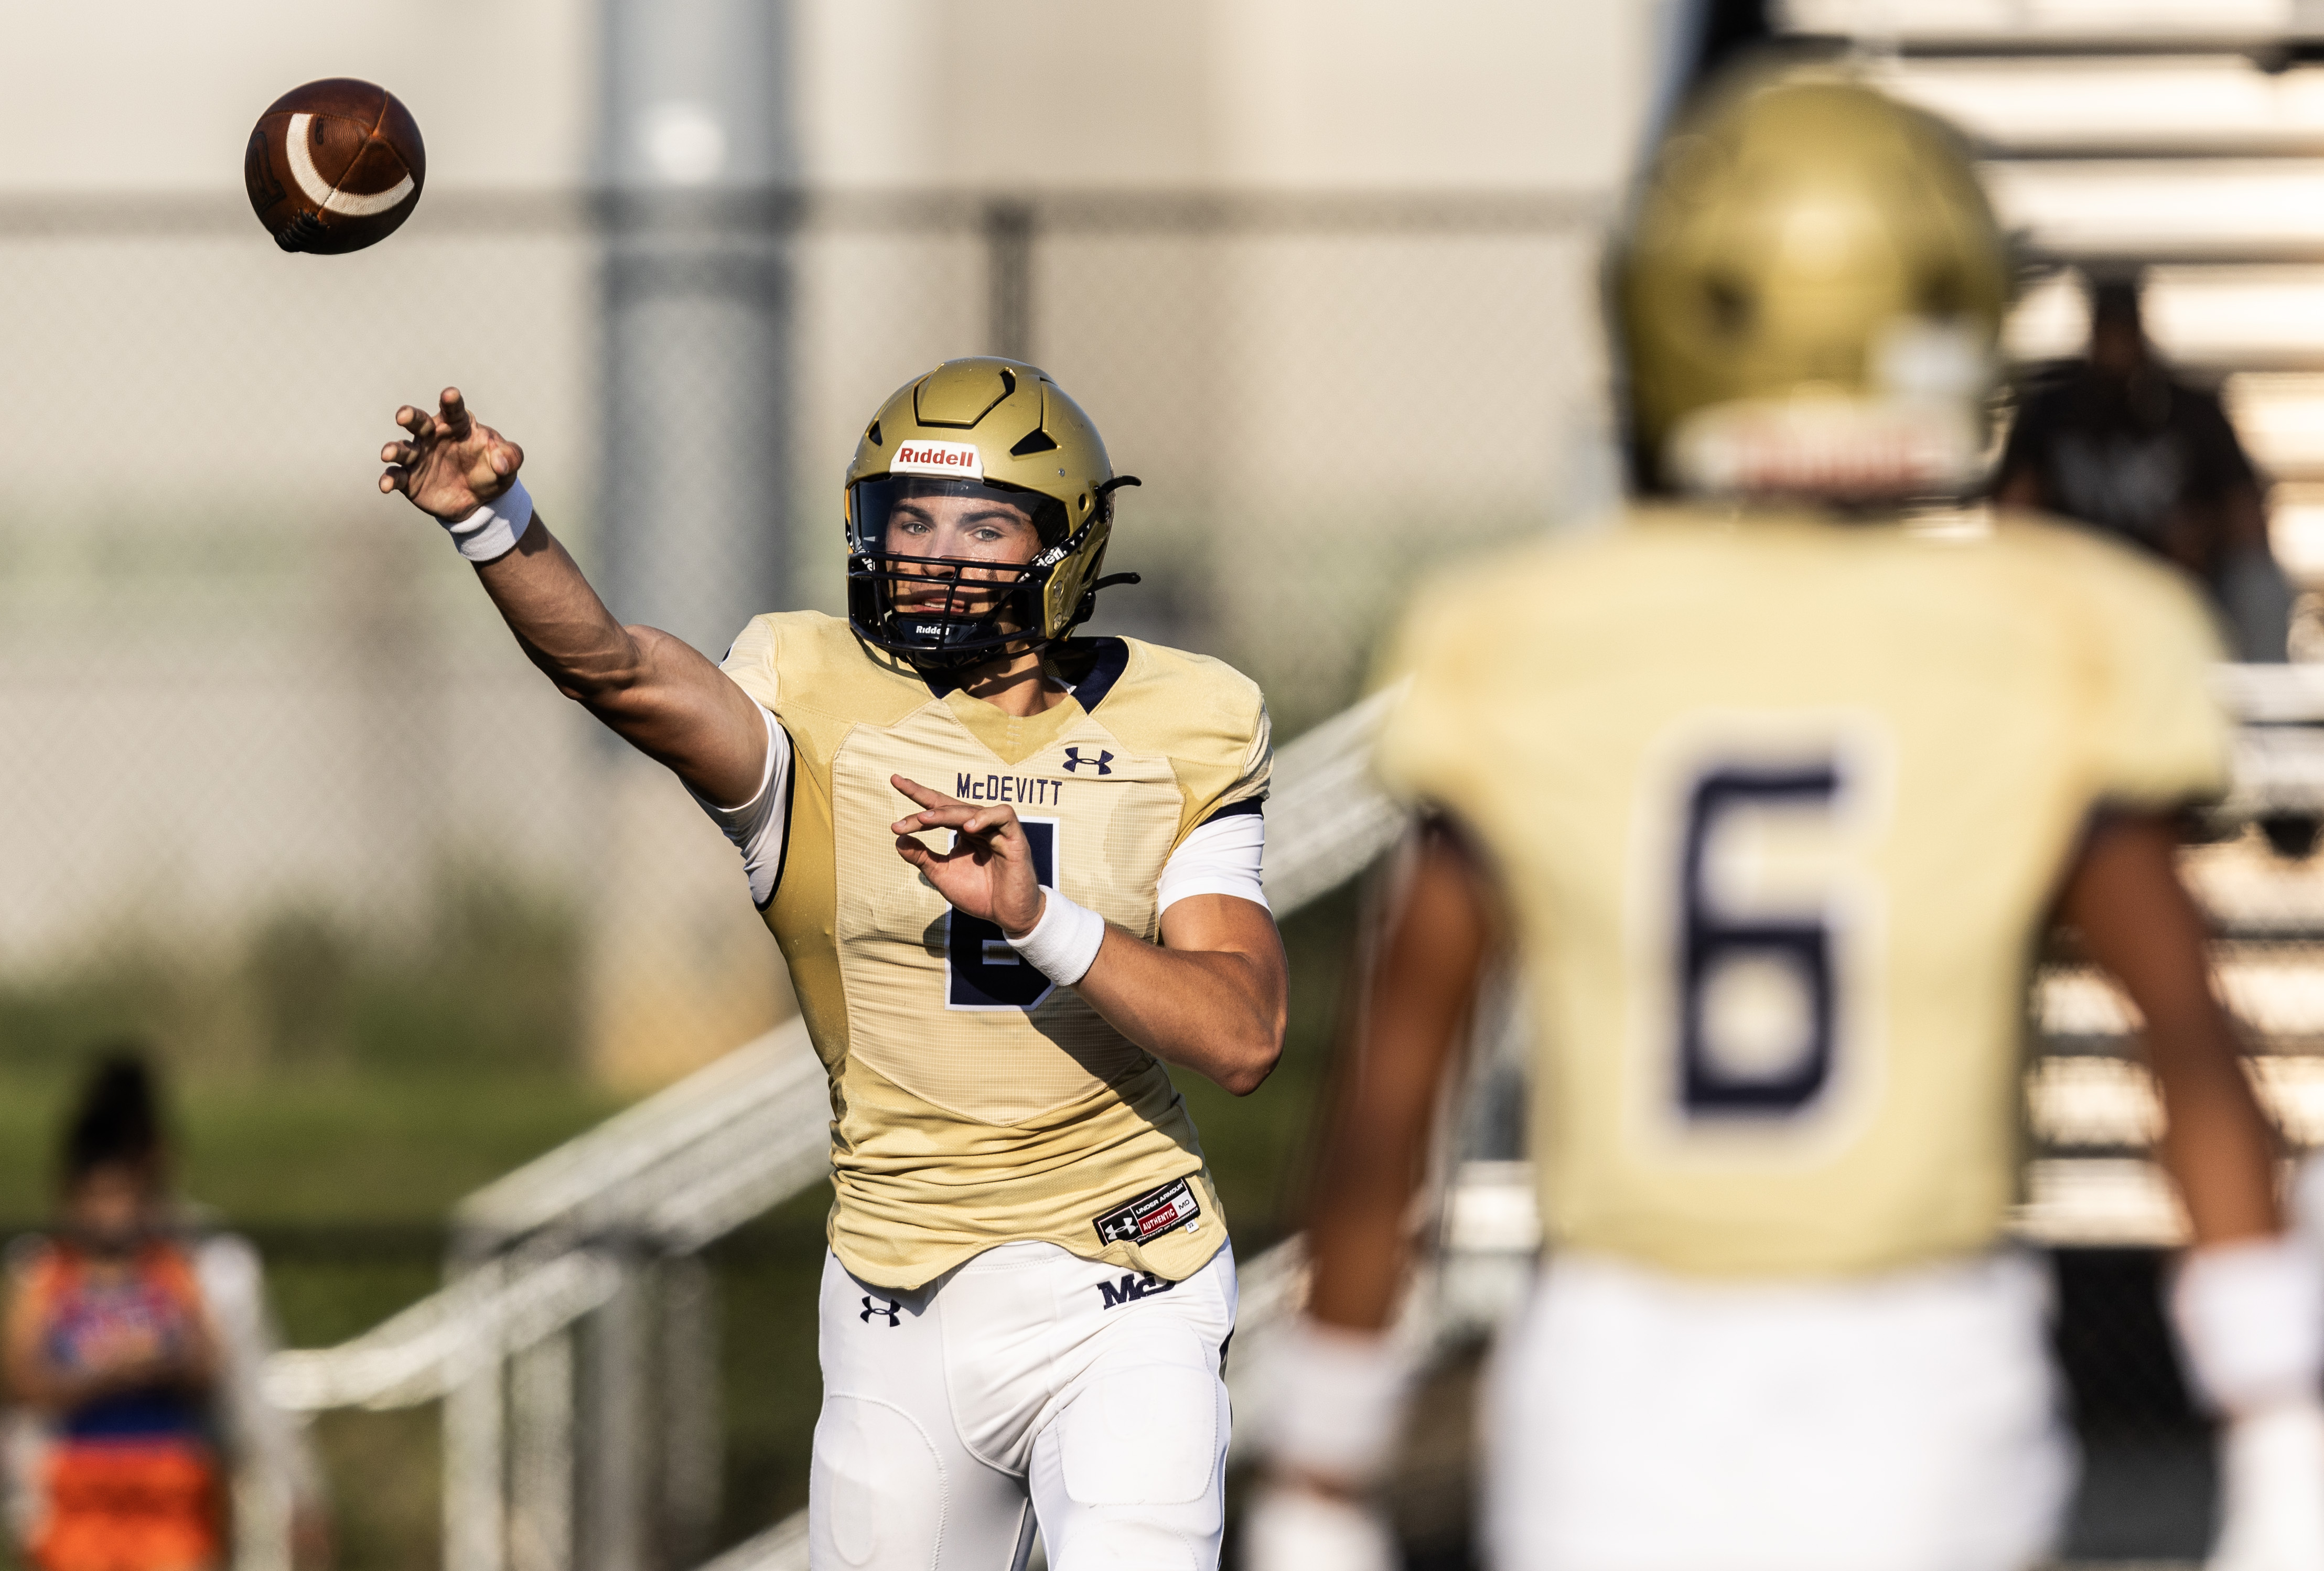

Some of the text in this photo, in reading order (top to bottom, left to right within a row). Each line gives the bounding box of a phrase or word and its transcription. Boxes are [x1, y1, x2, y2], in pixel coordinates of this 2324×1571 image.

[899, 448, 974, 467] Riddell
[916, 626, 950, 636] Riddel
[956, 772, 1063, 806] McDEVITT
[1670, 758, 1848, 1122] 6
[1136, 1183, 1183, 1214] UNDER ARMOUR
[1178, 1199, 1190, 1210] MD
[1143, 1208, 1175, 1231] AUTHENTIC
